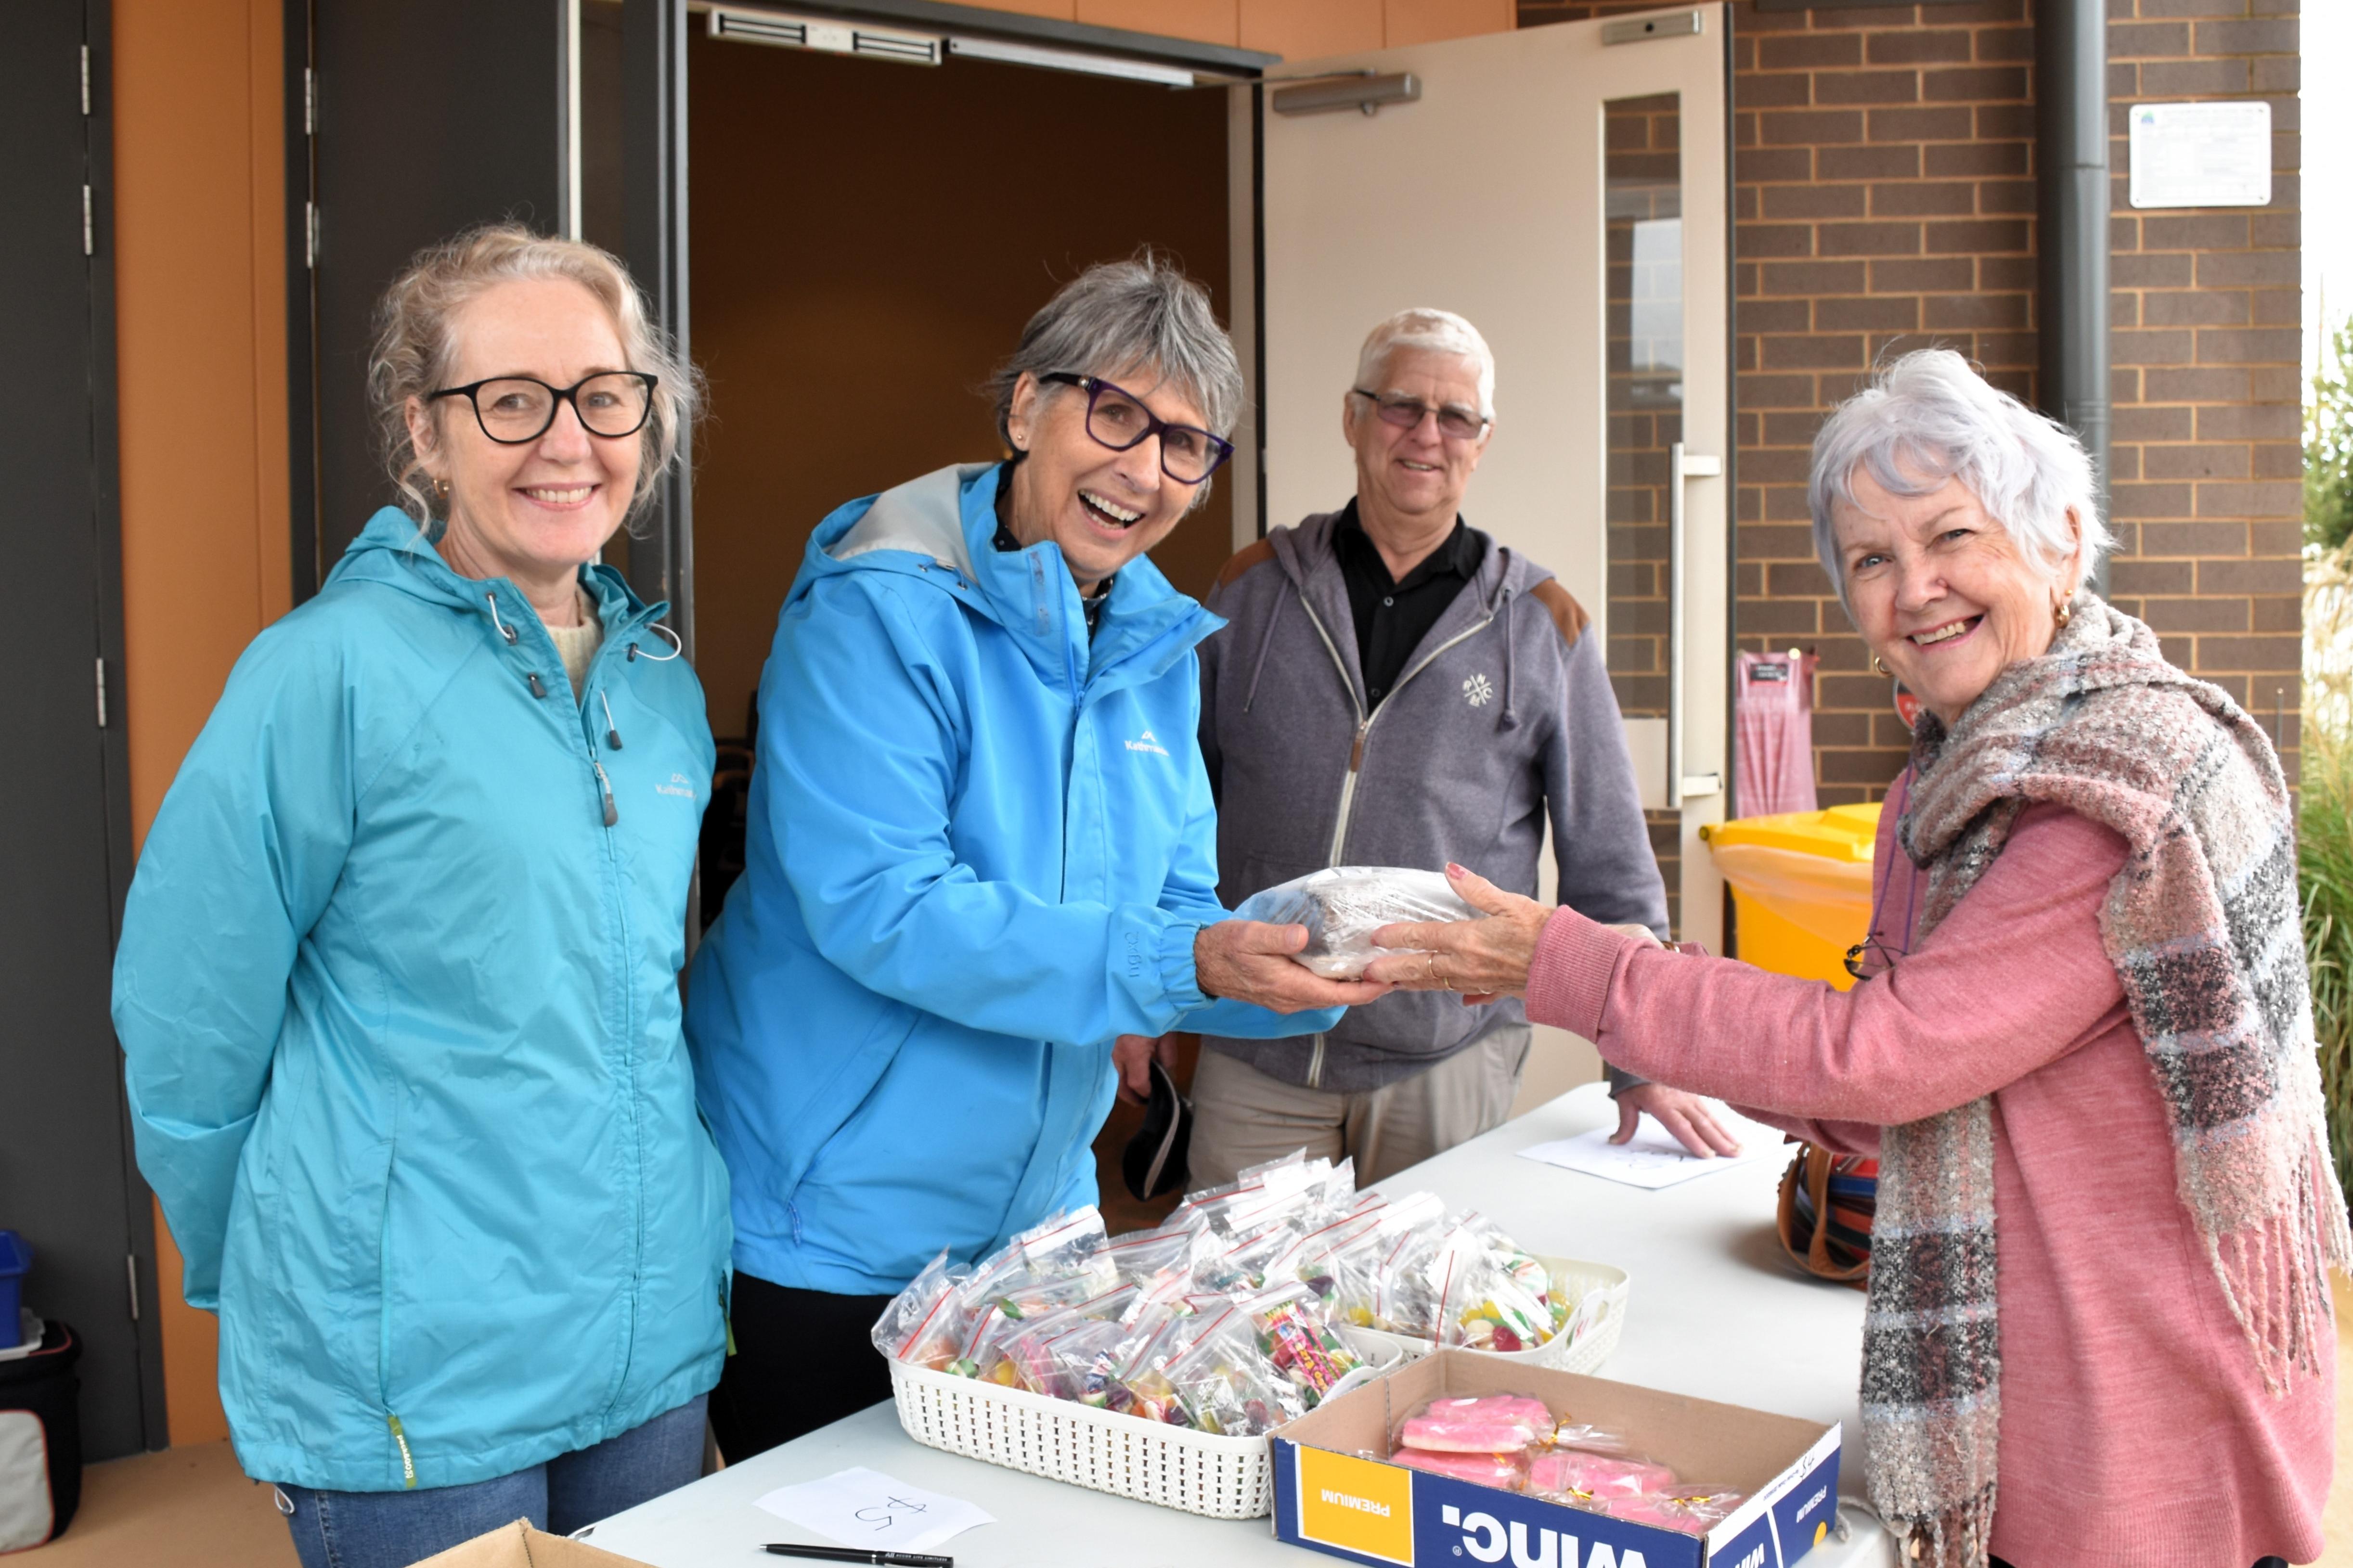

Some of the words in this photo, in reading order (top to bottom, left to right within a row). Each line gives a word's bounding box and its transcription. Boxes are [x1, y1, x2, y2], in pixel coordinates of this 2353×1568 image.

[854, 1496, 927, 1531] $5
[1321, 1489, 1390, 1517] PREMIUM
[1796, 1485, 1827, 1523] PREMIUM
